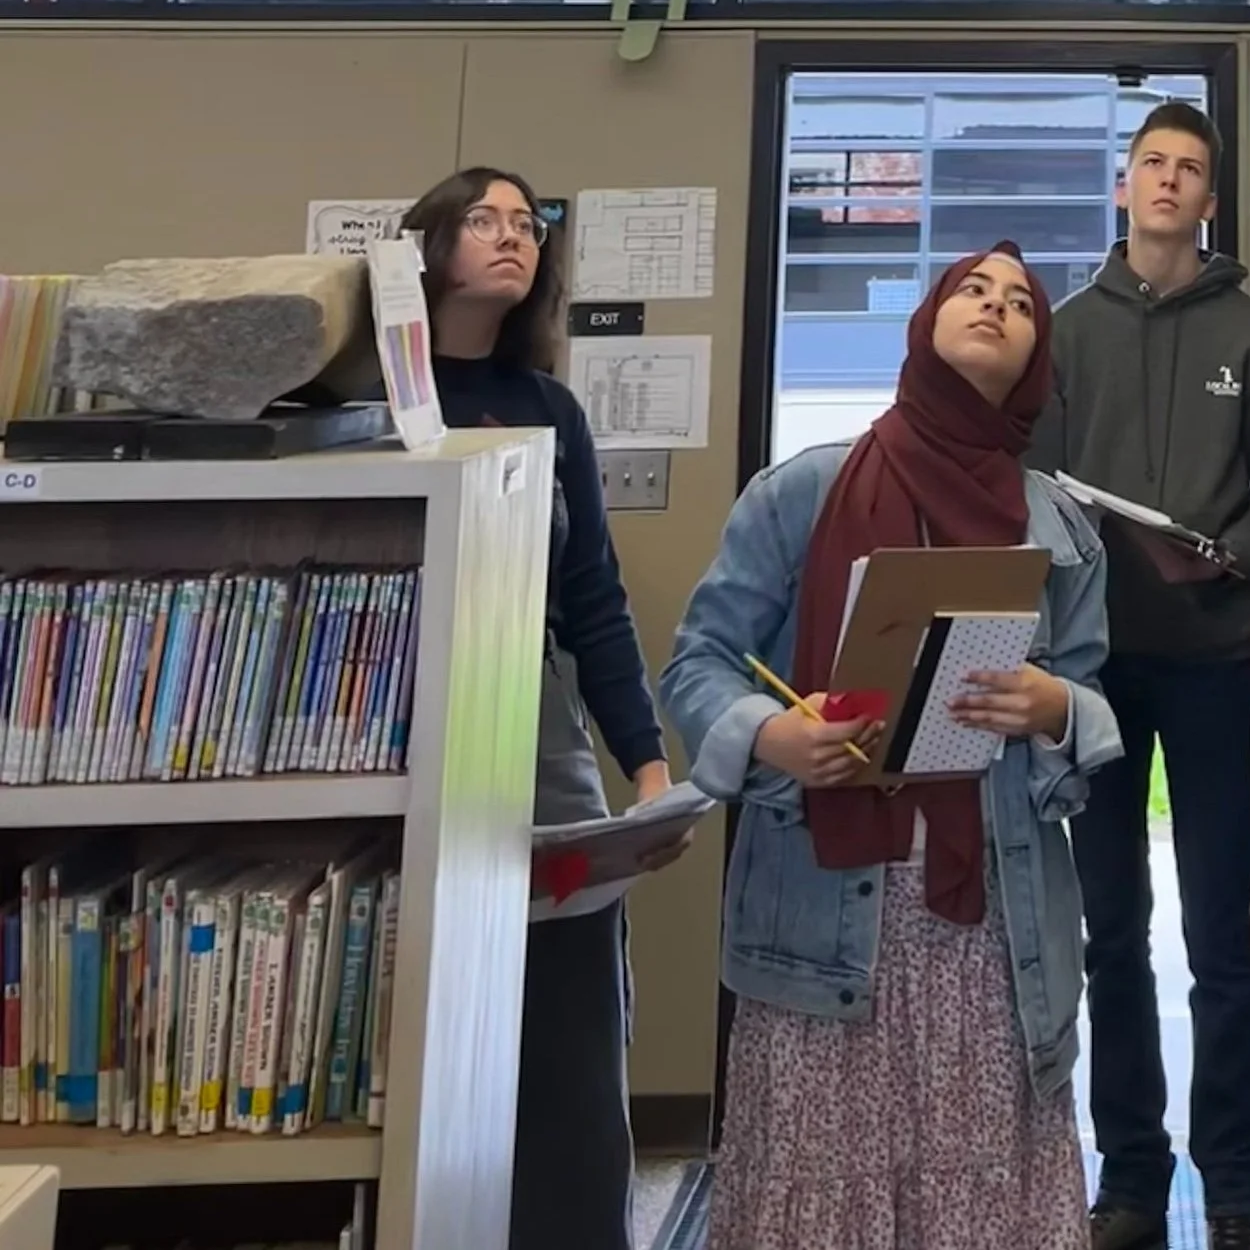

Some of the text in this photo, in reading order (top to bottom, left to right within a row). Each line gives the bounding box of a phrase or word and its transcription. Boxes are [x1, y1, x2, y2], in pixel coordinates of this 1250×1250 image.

[590, 312, 620, 326] EXIT
[5, 473, 37, 489] C-D
[264, 975, 276, 1020] AMBER
[259, 1024, 272, 1071] BROWN
